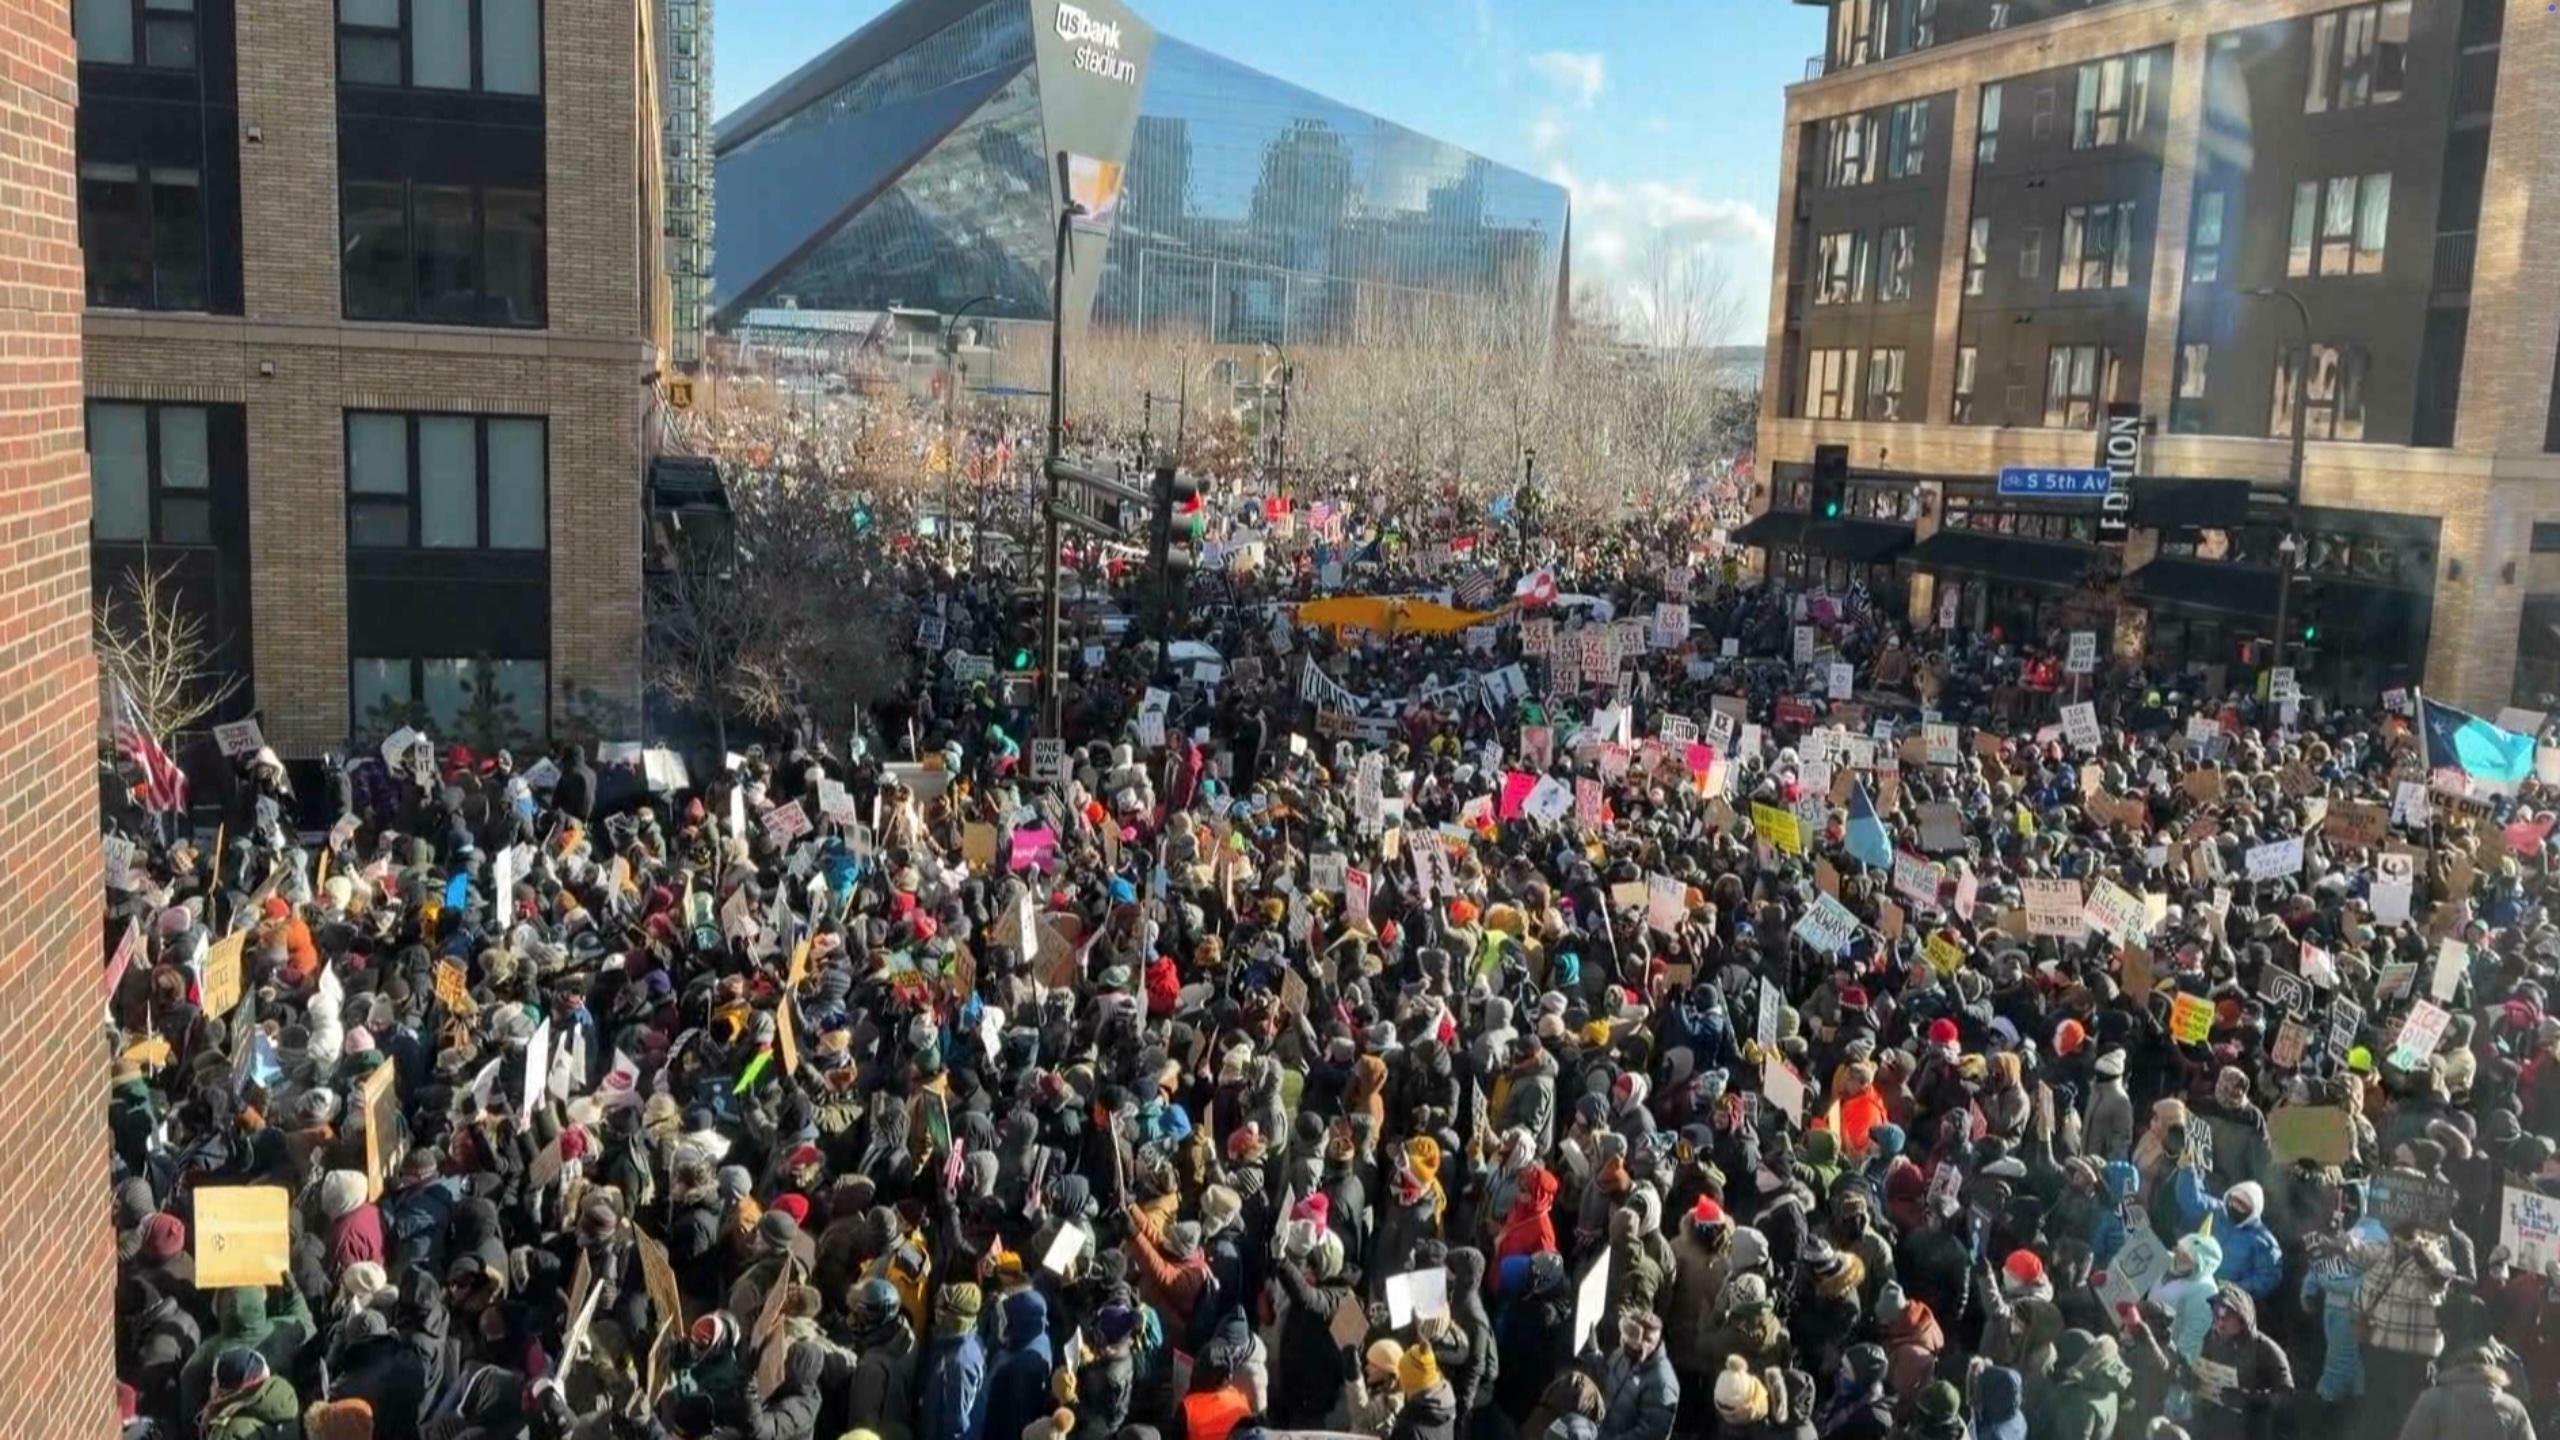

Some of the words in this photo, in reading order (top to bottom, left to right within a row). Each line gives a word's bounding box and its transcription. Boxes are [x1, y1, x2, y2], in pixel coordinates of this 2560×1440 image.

[1074, 45, 1135, 85] stadium
[2027, 473, 2038, 489] S
[2046, 474, 2076, 490] 5th
[2082, 476, 2107, 490] Av
[1675, 724, 1697, 739] STOP
[1036, 742, 1059, 753] ONE
[1035, 753, 1058, 766] WAY
[2428, 792, 2452, 808] ICE
[2457, 801, 2492, 820] OUT
